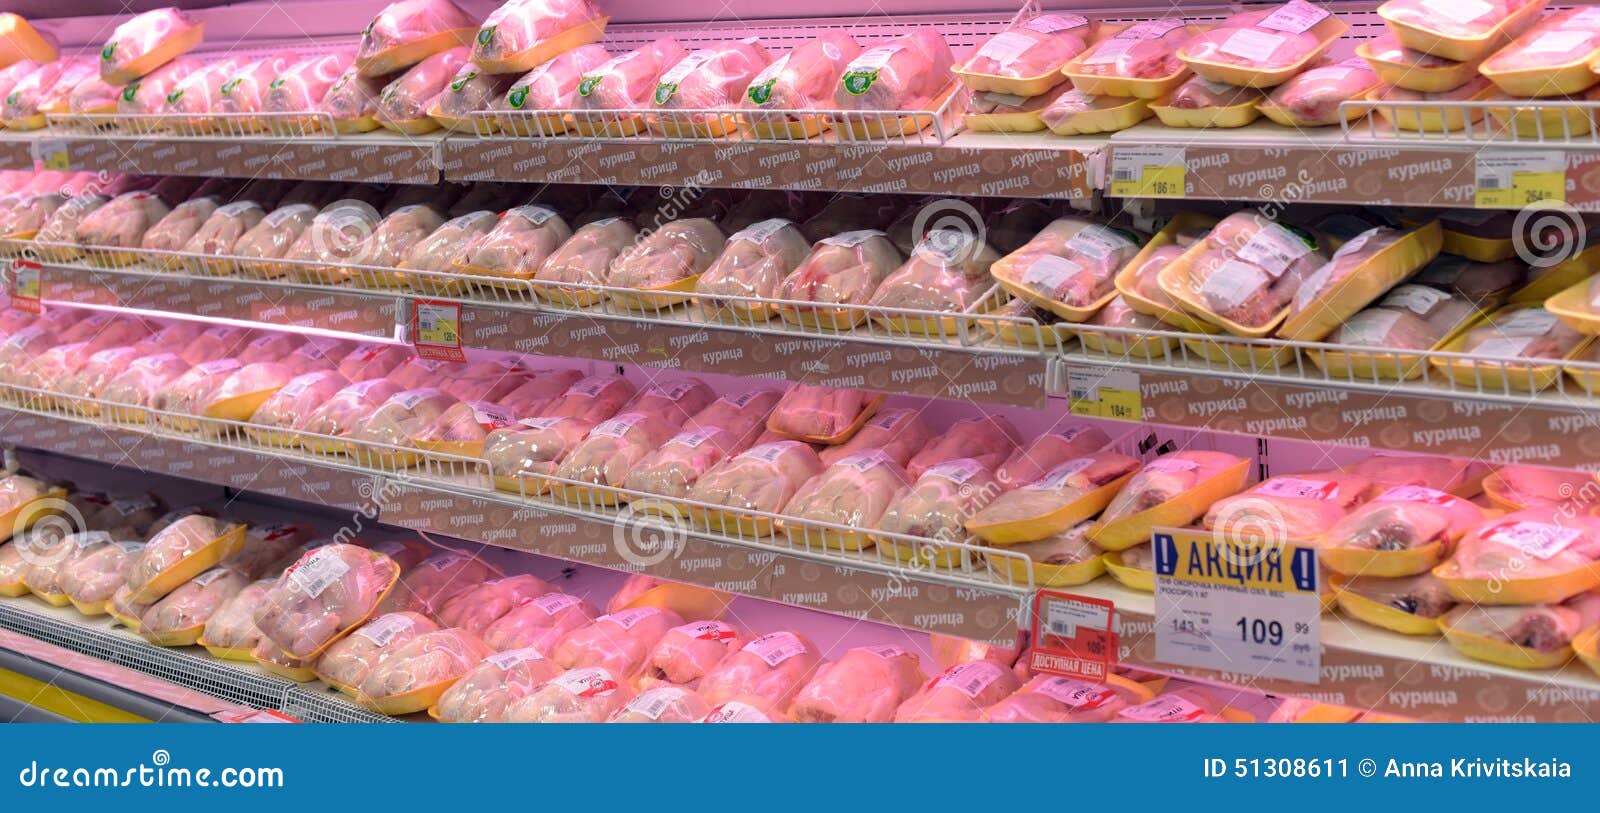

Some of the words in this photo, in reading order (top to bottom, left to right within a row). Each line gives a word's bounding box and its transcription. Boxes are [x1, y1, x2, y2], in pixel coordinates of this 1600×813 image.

[480, 146, 512, 161] курица
[513, 155, 545, 170] курица
[599, 149, 636, 167] курица
[759, 149, 801, 168] курица
[887, 150, 933, 172] курица
[1010, 148, 1059, 169] курица
[546, 165, 580, 181] курица
[640, 160, 677, 177] курица
[933, 163, 980, 183] курица
[1228, 165, 1286, 187] курица
[1388, 157, 1452, 179] курица
[980, 174, 1029, 194] курица
[475, 323, 508, 338] курица
[570, 324, 606, 340] курица
[669, 331, 709, 348] курица
[515, 335, 549, 350] курица
[602, 342, 639, 358] курица
[703, 347, 743, 364] курица
[847, 349, 892, 368] курица
[892, 365, 938, 384] курица
[948, 378, 997, 397] курица
[1142, 378, 1188, 399] урица
[1188, 396, 1247, 417] курица
[1285, 389, 1348, 409] курица
[1342, 405, 1406, 424] курица
[1246, 415, 1306, 437] курица
[1413, 425, 1481, 447] курица
[1489, 443, 1560, 464] курица
[421, 498, 453, 512] курица
[450, 513, 484, 527] курица
[482, 527, 517, 542] курица
[540, 522, 577, 537] курица
[569, 541, 607, 557] курица
[680, 556, 722, 572] курица
[1188, 541, 1282, 585] АКЦИЯ
[714, 575, 757, 591] курица
[783, 590, 828, 606] курица
[871, 585, 919, 601] курица
[914, 611, 964, 628] курица
[1172, 619, 1195, 632] 143
[1236, 616, 1283, 646] 109
[1294, 622, 1310, 635] 99
[1032, 654, 1079, 673] ДОСТУПНАЯ
[1080, 659, 1103, 676] ЦЕНА
[1390, 689, 1457, 709] курица
